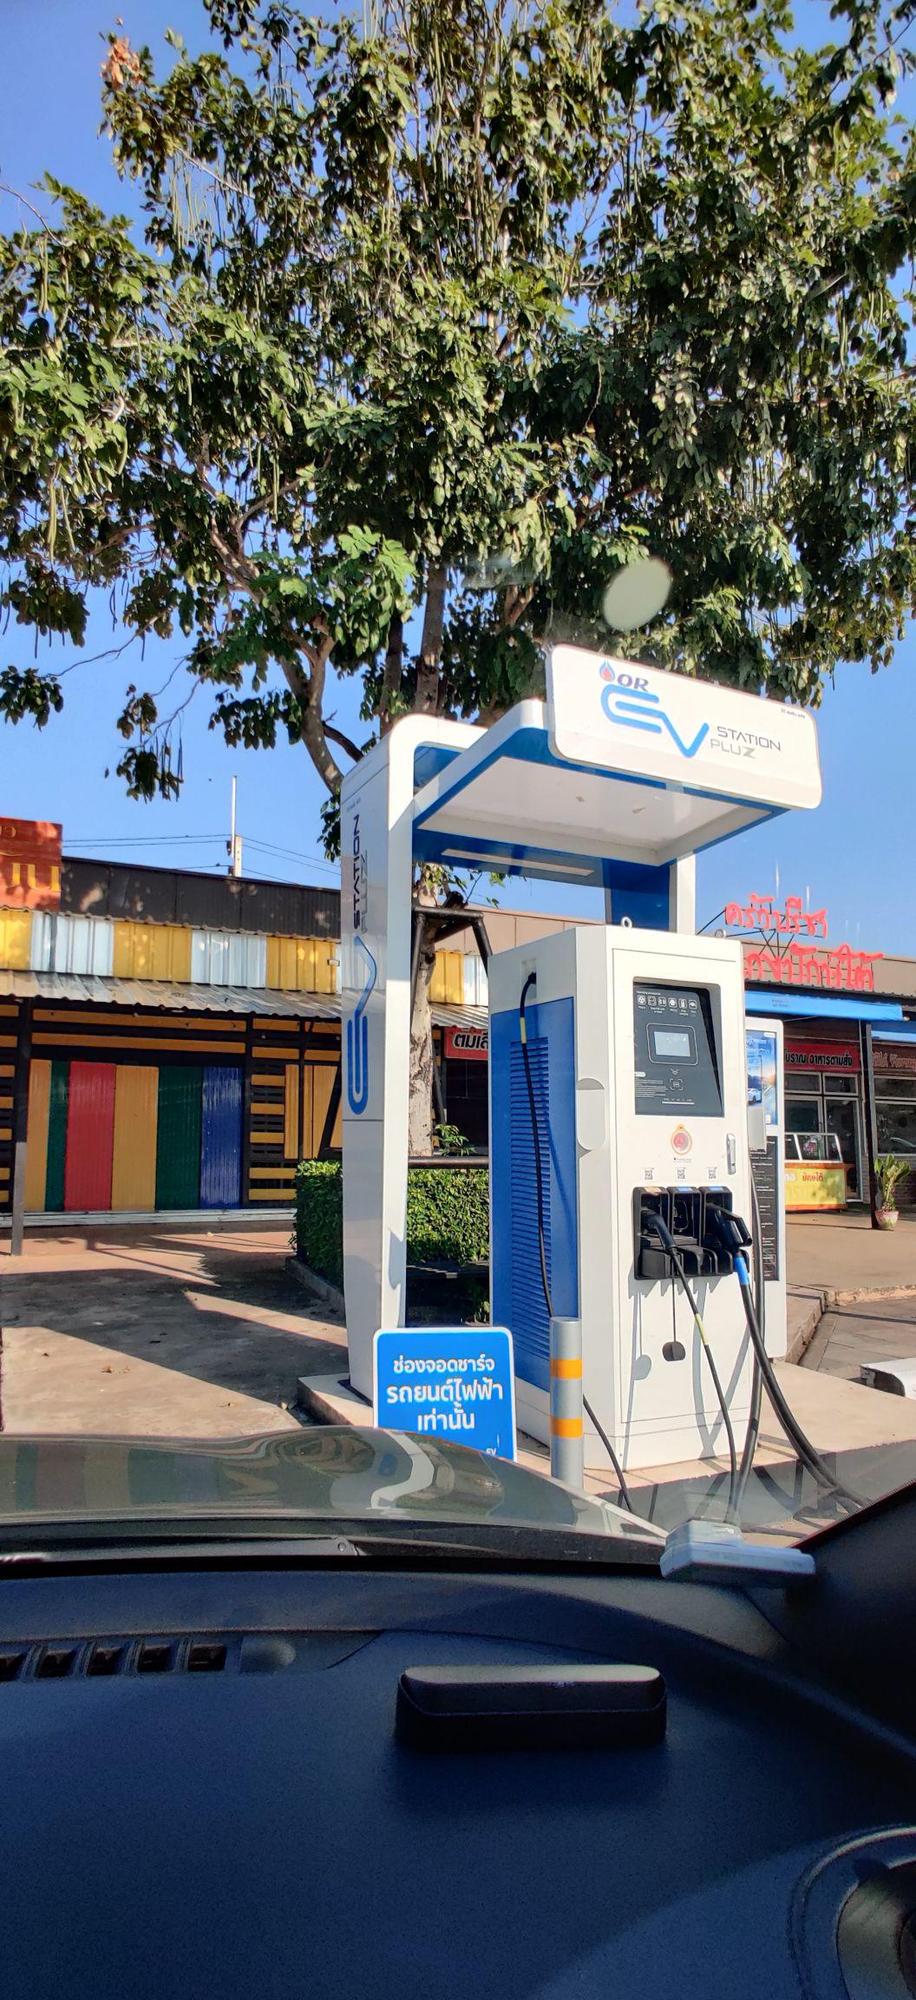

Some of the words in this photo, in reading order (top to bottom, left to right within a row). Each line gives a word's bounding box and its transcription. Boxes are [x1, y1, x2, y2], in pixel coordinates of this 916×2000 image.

[616, 673, 650, 692] OR
[600, 684, 710, 759] EV
[709, 738, 757, 760] PLUZ
[716, 725, 782, 752] STATION
[393, 1354, 496, 1374] ช่องจอดชาร์จ
[386, 1377, 504, 1404] รถยนต์ไฟฟ้า
[417, 1401, 476, 1432] เท่านั้น
